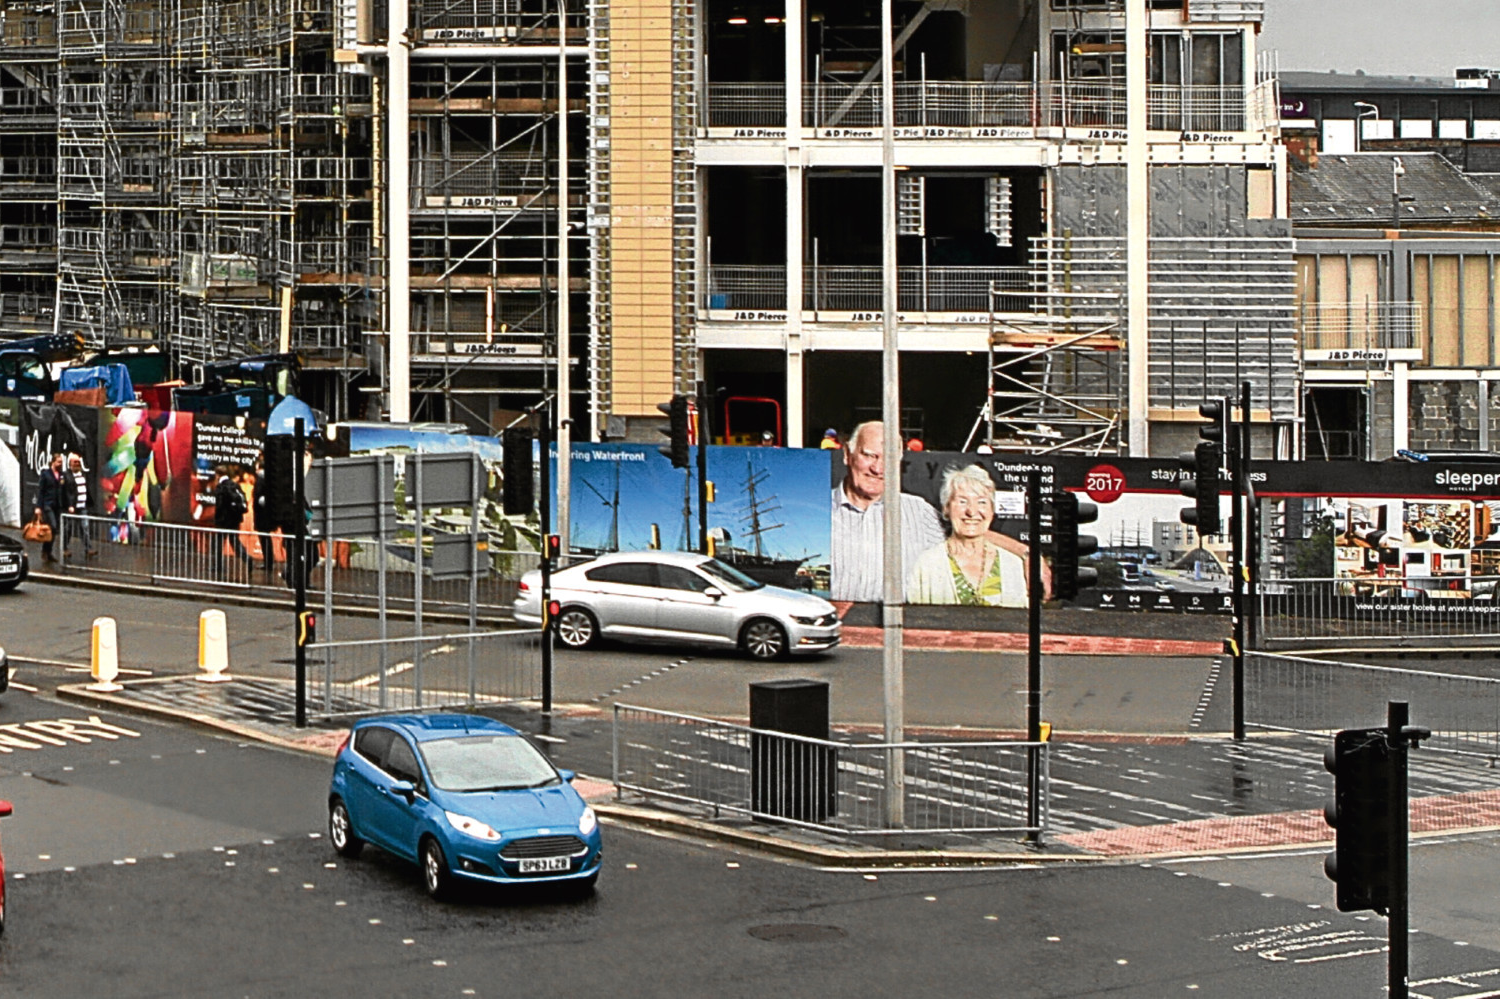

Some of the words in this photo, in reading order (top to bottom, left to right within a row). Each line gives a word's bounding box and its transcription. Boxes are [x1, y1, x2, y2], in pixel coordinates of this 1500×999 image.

[734, 129, 754, 137] J&D
[757, 129, 787, 137] Pierce
[843, 129, 873, 137] Pierce
[977, 129, 998, 137] J&D
[1088, 130, 1109, 138] J&D
[1112, 131, 1128, 139] Pie
[1203, 133, 1233, 142] Pierce
[734, 312, 755, 320] J&D
[758, 312, 787, 321] Pierce
[852, 313, 872, 321] J&D
[1328, 351, 1349, 360] J&D
[223, 436, 234, 444] the
[549, 448, 591, 462] Inring
[591, 450, 646, 462] Waterfront
[1041, 465, 1054, 474] on
[1003, 473, 1020, 482] the
[1151, 468, 1177, 482] stay
[1179, 468, 1191, 480] in
[1087, 478, 1123, 491] 2017
